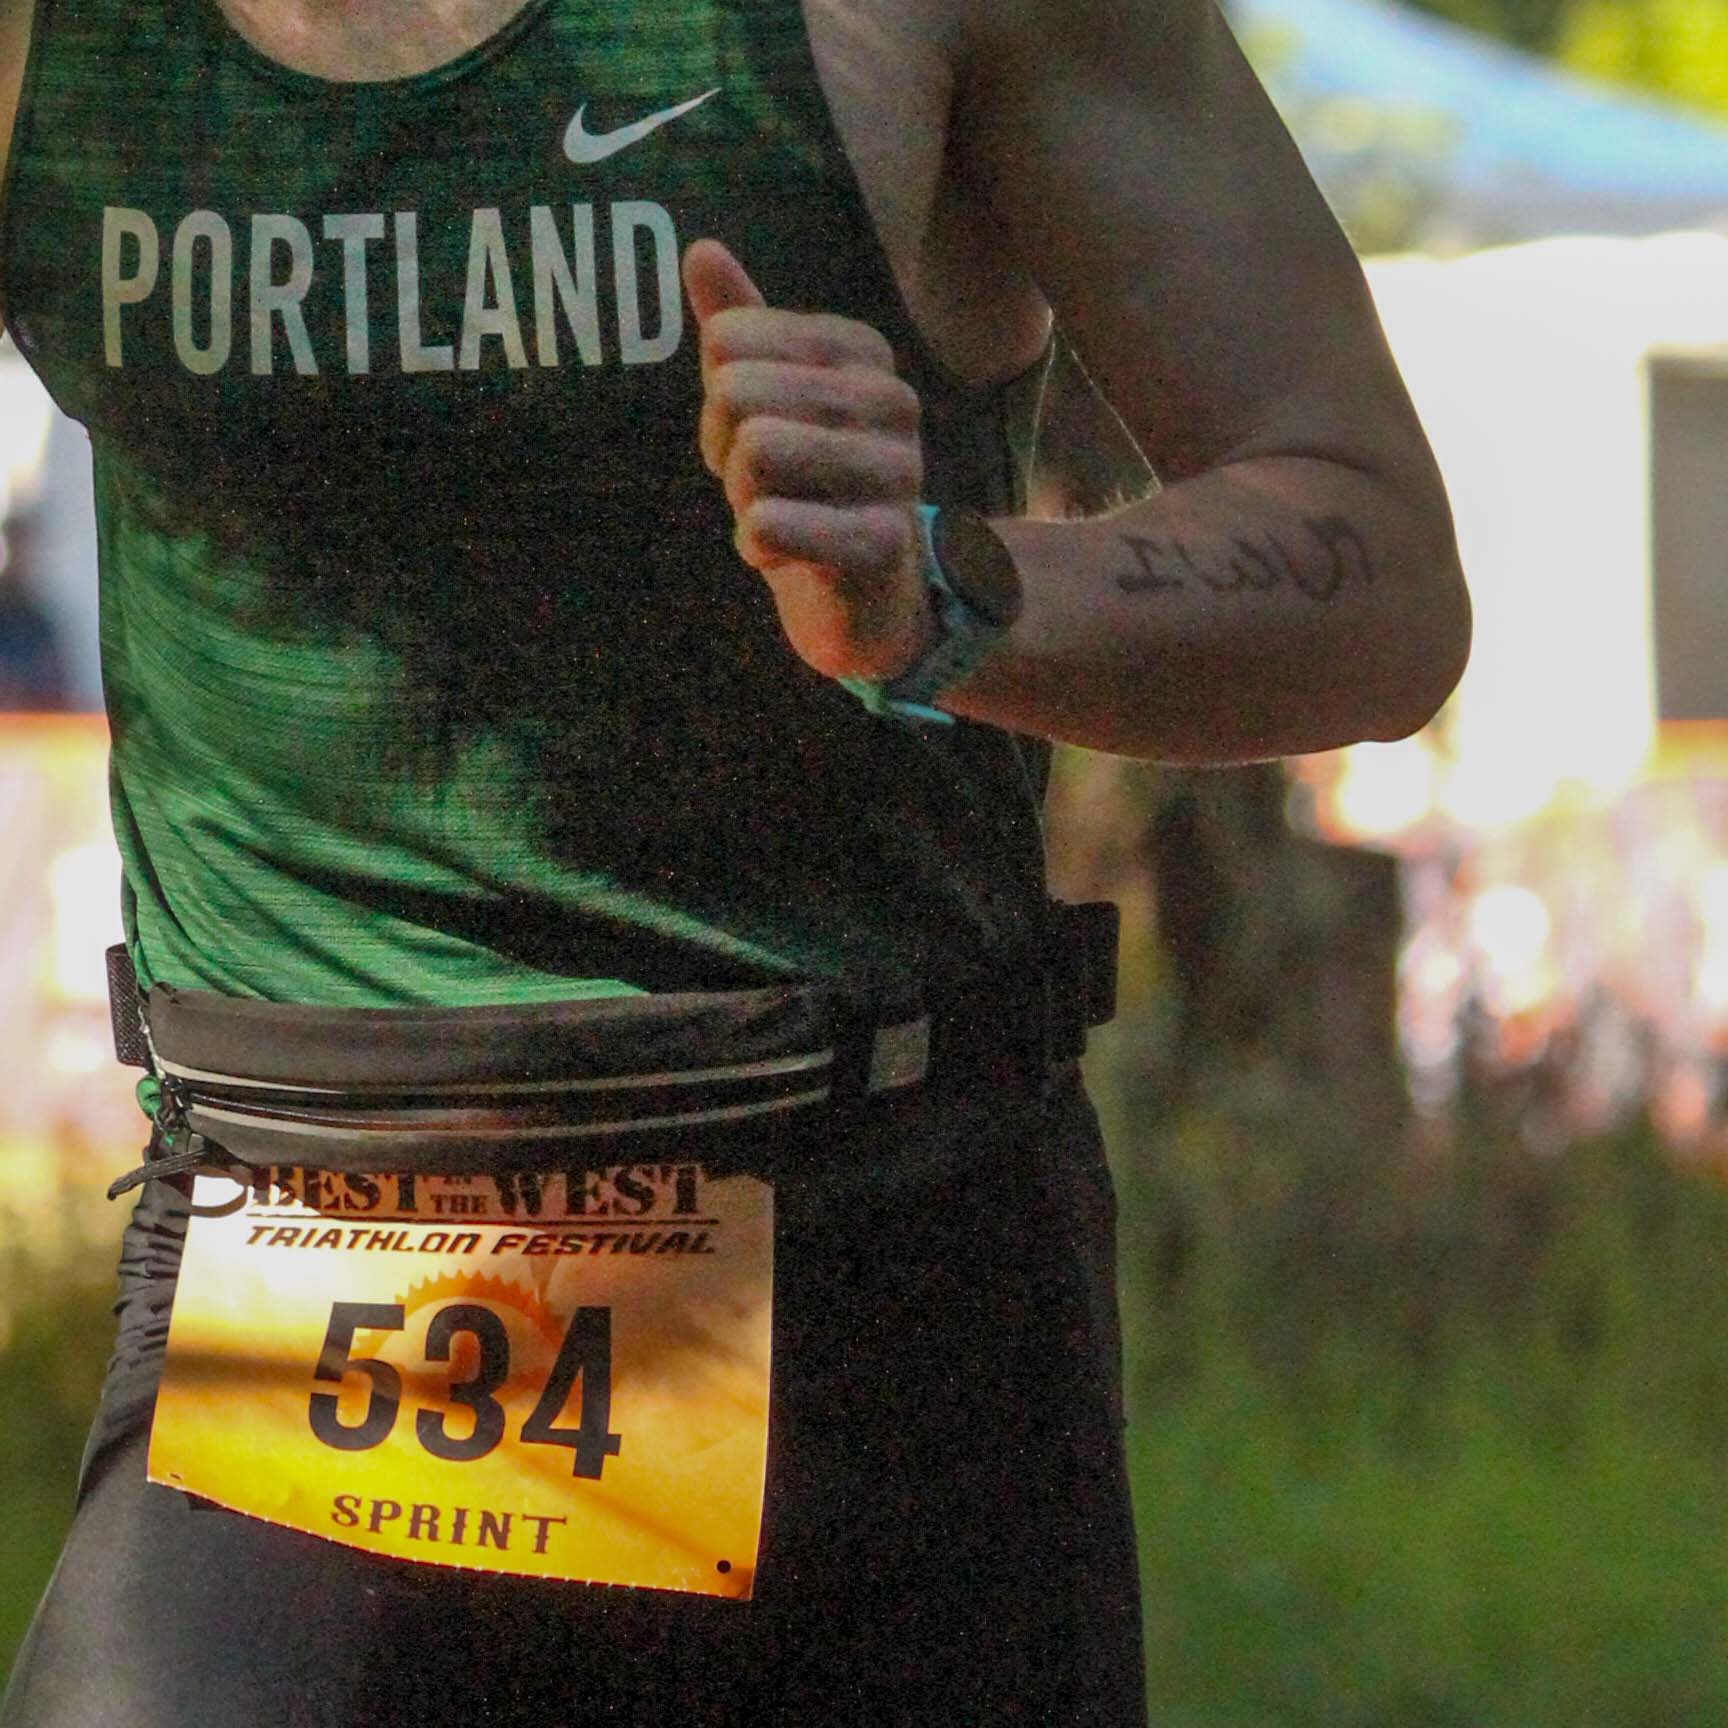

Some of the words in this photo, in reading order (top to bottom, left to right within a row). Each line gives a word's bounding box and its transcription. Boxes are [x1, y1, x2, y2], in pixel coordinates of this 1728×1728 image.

[102, 201, 683, 375] PORTLAND
[250, 1166, 428, 1212] BEST
[430, 1194, 488, 1214] THE
[494, 1166, 710, 1215] WEST
[246, 1225, 481, 1254] TRIATHLON
[491, 1233, 715, 1255] FESTIVAL
[308, 1302, 621, 1480] 534
[330, 1494, 568, 1555] SPRINT
